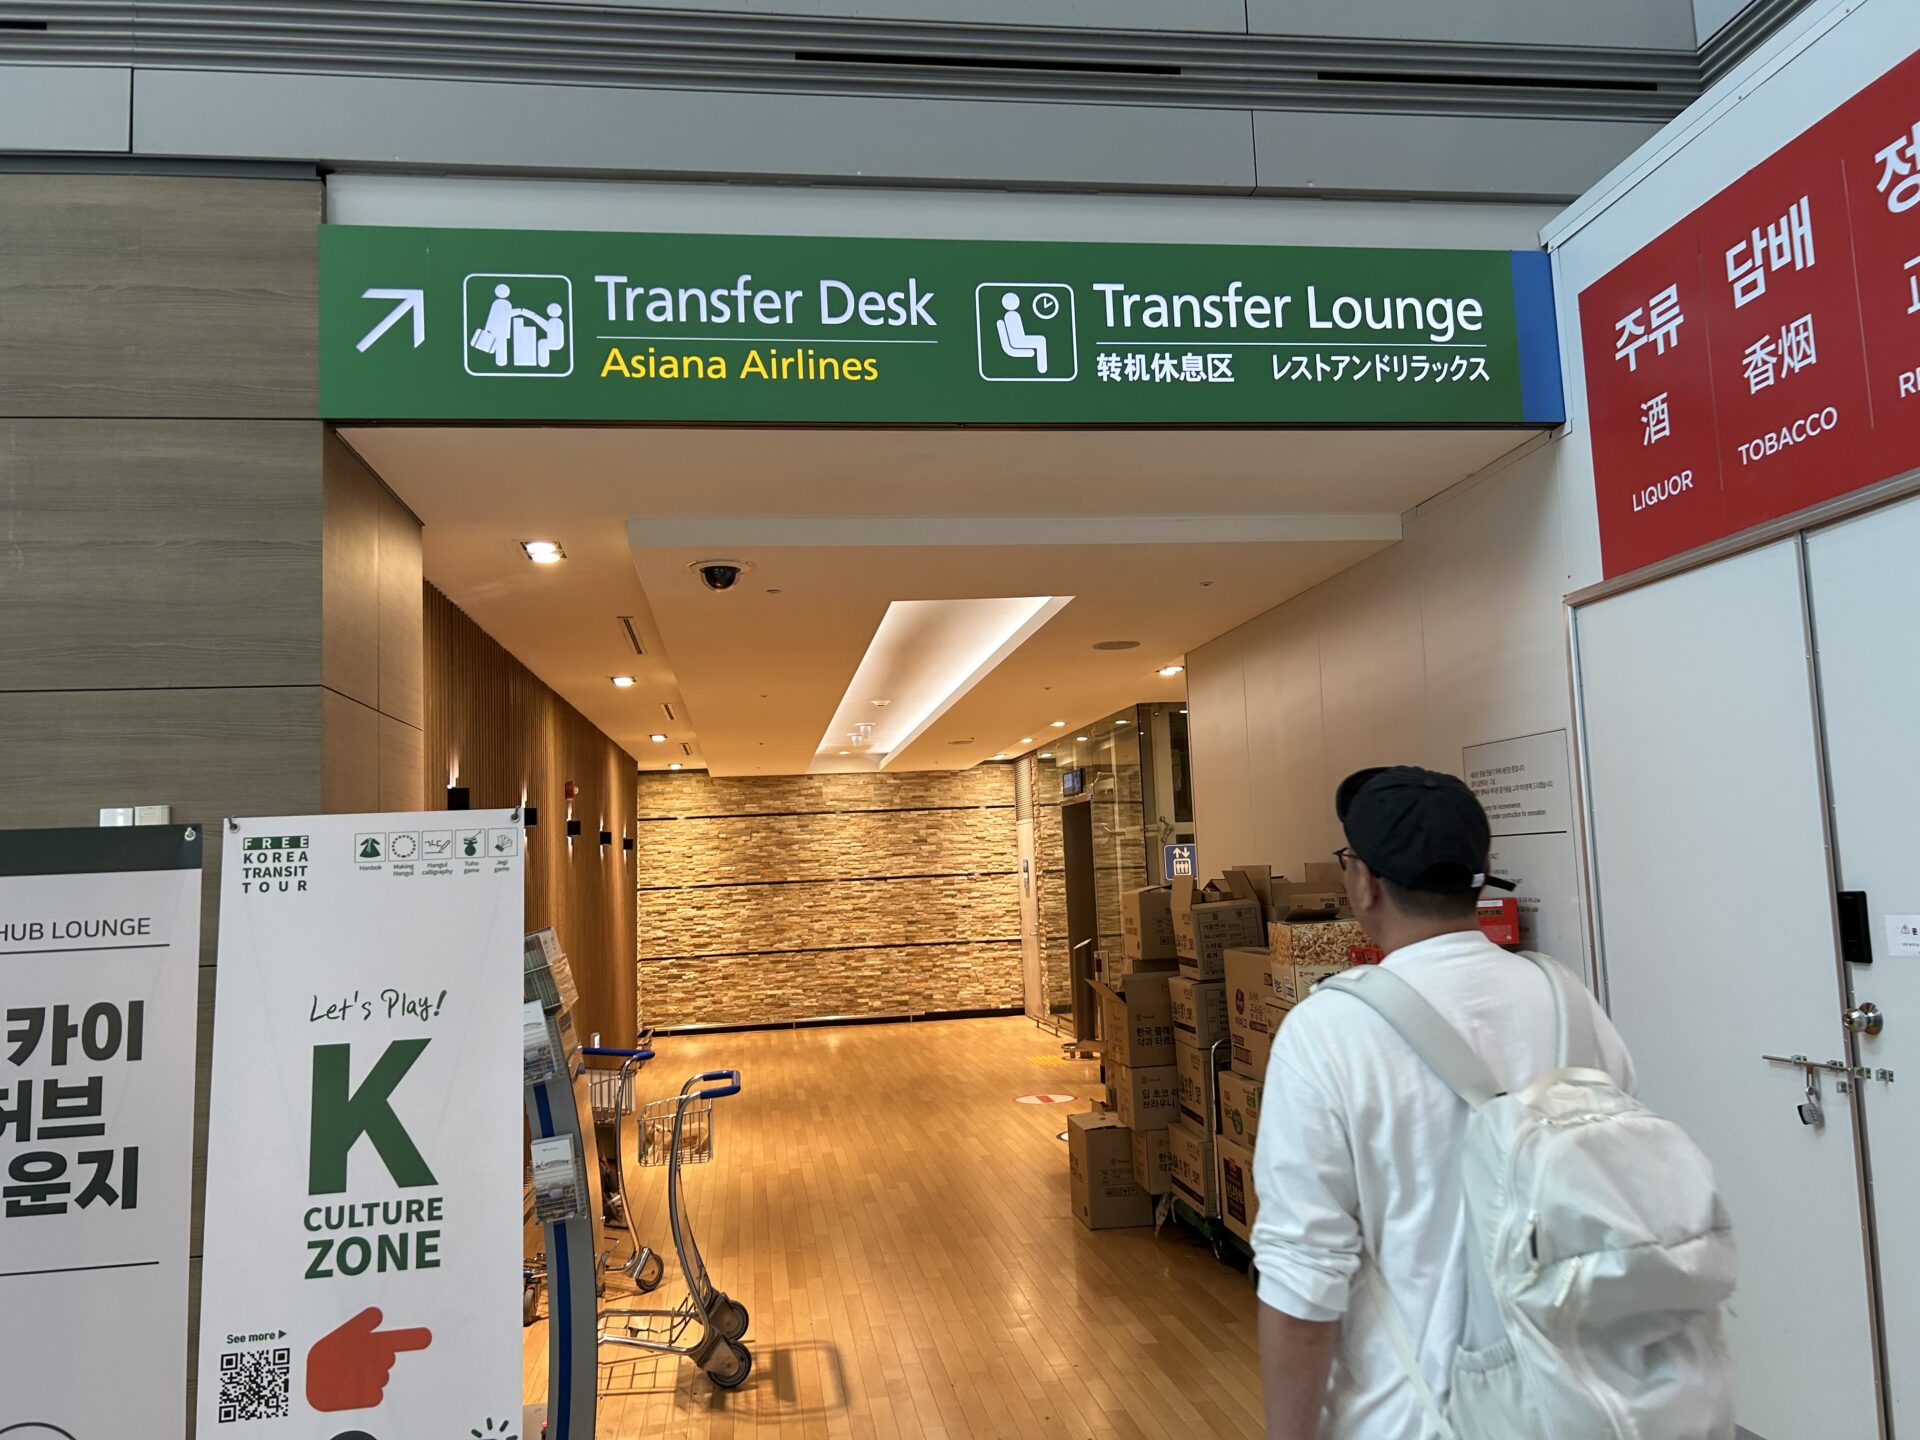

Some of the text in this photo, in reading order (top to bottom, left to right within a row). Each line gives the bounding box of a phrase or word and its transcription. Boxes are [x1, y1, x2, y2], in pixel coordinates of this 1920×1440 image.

[1725, 195, 1816, 310] 담배
[595, 275, 938, 326] Transfer Desk
[1092, 281, 1483, 342] Transfer Lounge
[1614, 283, 1685, 373] 주류
[600, 347, 879, 381] Asiana Airlines
[1096, 352, 1235, 383] 转机休息区
[1272, 353, 1490, 383] レストアンドリラックス
[1742, 313, 1817, 395] 香烟
[1640, 392, 1671, 446] 酒
[1737, 406, 1838, 466] TOBACCO
[1632, 470, 1694, 512] LIQUOR
[243, 850, 308, 864] KOREA
[244, 836, 308, 849] FREE
[241, 879, 308, 894] TOUR
[242, 865, 308, 879] TRANSIT
[52, 918, 151, 940] LOUNGE
[310, 989, 447, 1022] Let's Play!
[6, 1000, 144, 1066] 카이
[308, 1037, 439, 1196] K
[3, 1146, 139, 1218] 운지
[304, 1197, 443, 1231] CULTURE
[304, 1230, 441, 1279] ZONE
[226, 1332, 276, 1344] See more
